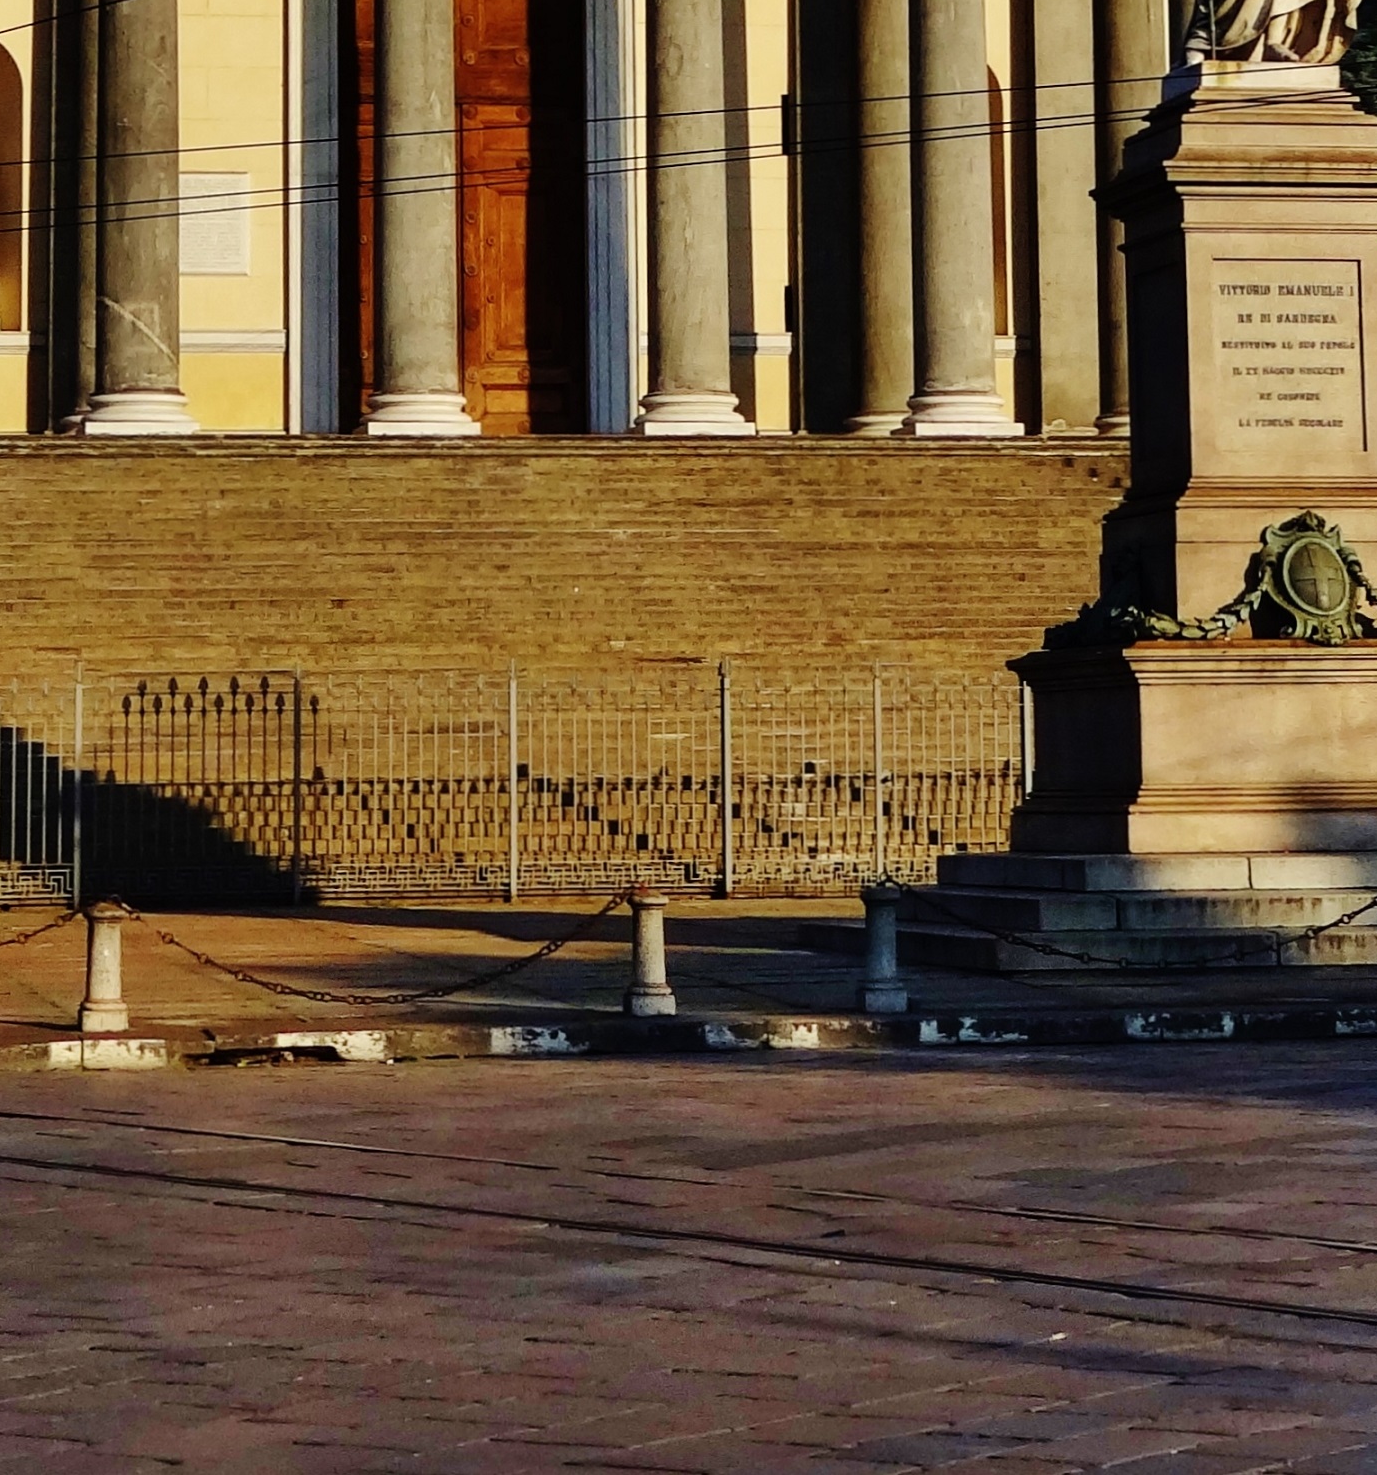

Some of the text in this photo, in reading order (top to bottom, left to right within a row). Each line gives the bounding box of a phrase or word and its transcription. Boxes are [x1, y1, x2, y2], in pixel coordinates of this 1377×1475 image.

[1218, 284, 1271, 296] VITTORIO
[1277, 285, 1344, 297] EMANUELE
[1237, 313, 1338, 324] RE DI SARDEGNA
